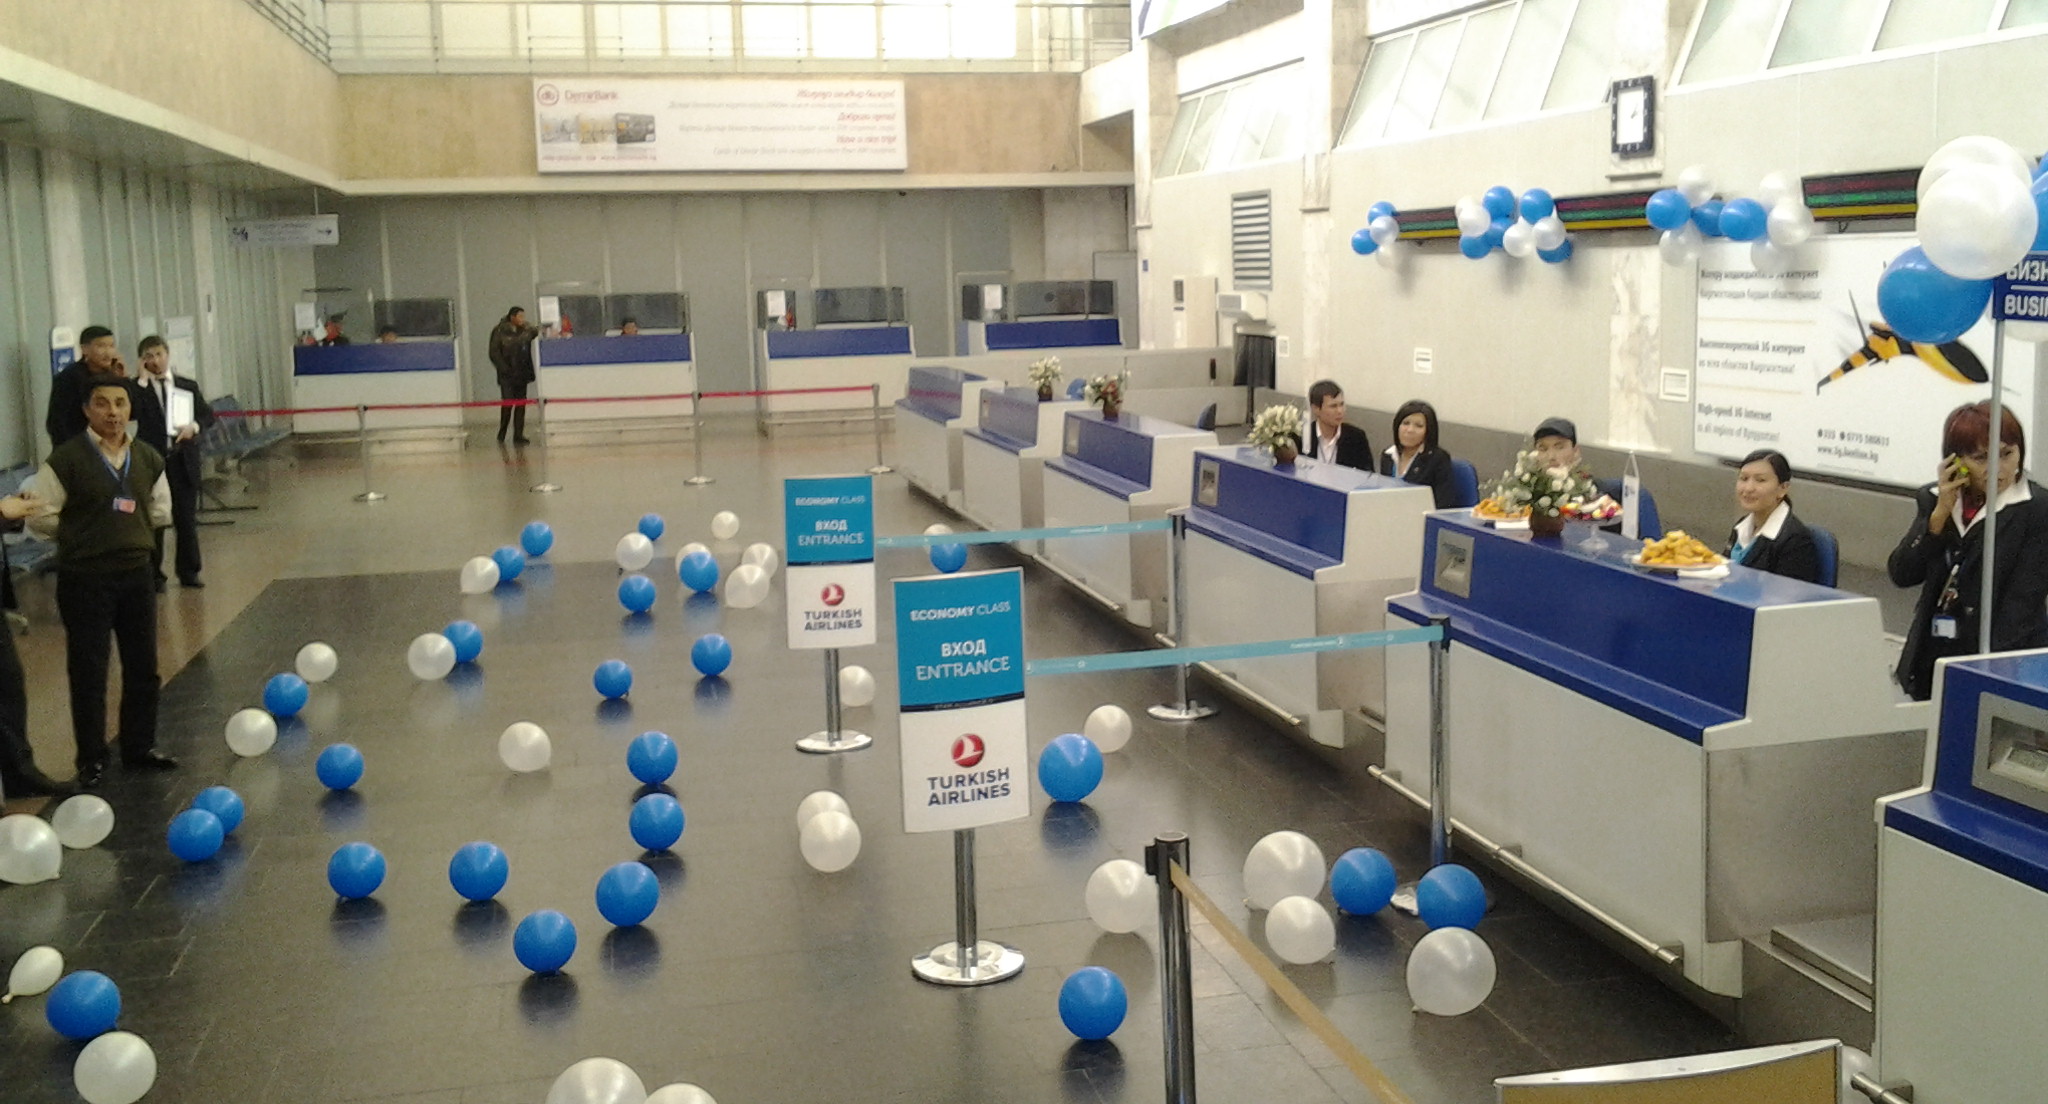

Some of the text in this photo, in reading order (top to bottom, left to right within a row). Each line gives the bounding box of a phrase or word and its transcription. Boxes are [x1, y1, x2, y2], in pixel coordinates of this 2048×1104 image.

[795, 497, 839, 506] ECONOMY
[815, 519, 848, 532] ВХОД
[798, 533, 865, 546] ENTRANCE
[804, 608, 862, 620] TURKISH
[910, 601, 1011, 621] ECONOMY CLASS
[804, 620, 862, 631] AIRLINES
[941, 639, 987, 657] ВХОД
[916, 656, 1011, 680] ENTRANCE
[927, 767, 1010, 791] TURKISH
[928, 783, 1012, 806] AIRLINES
